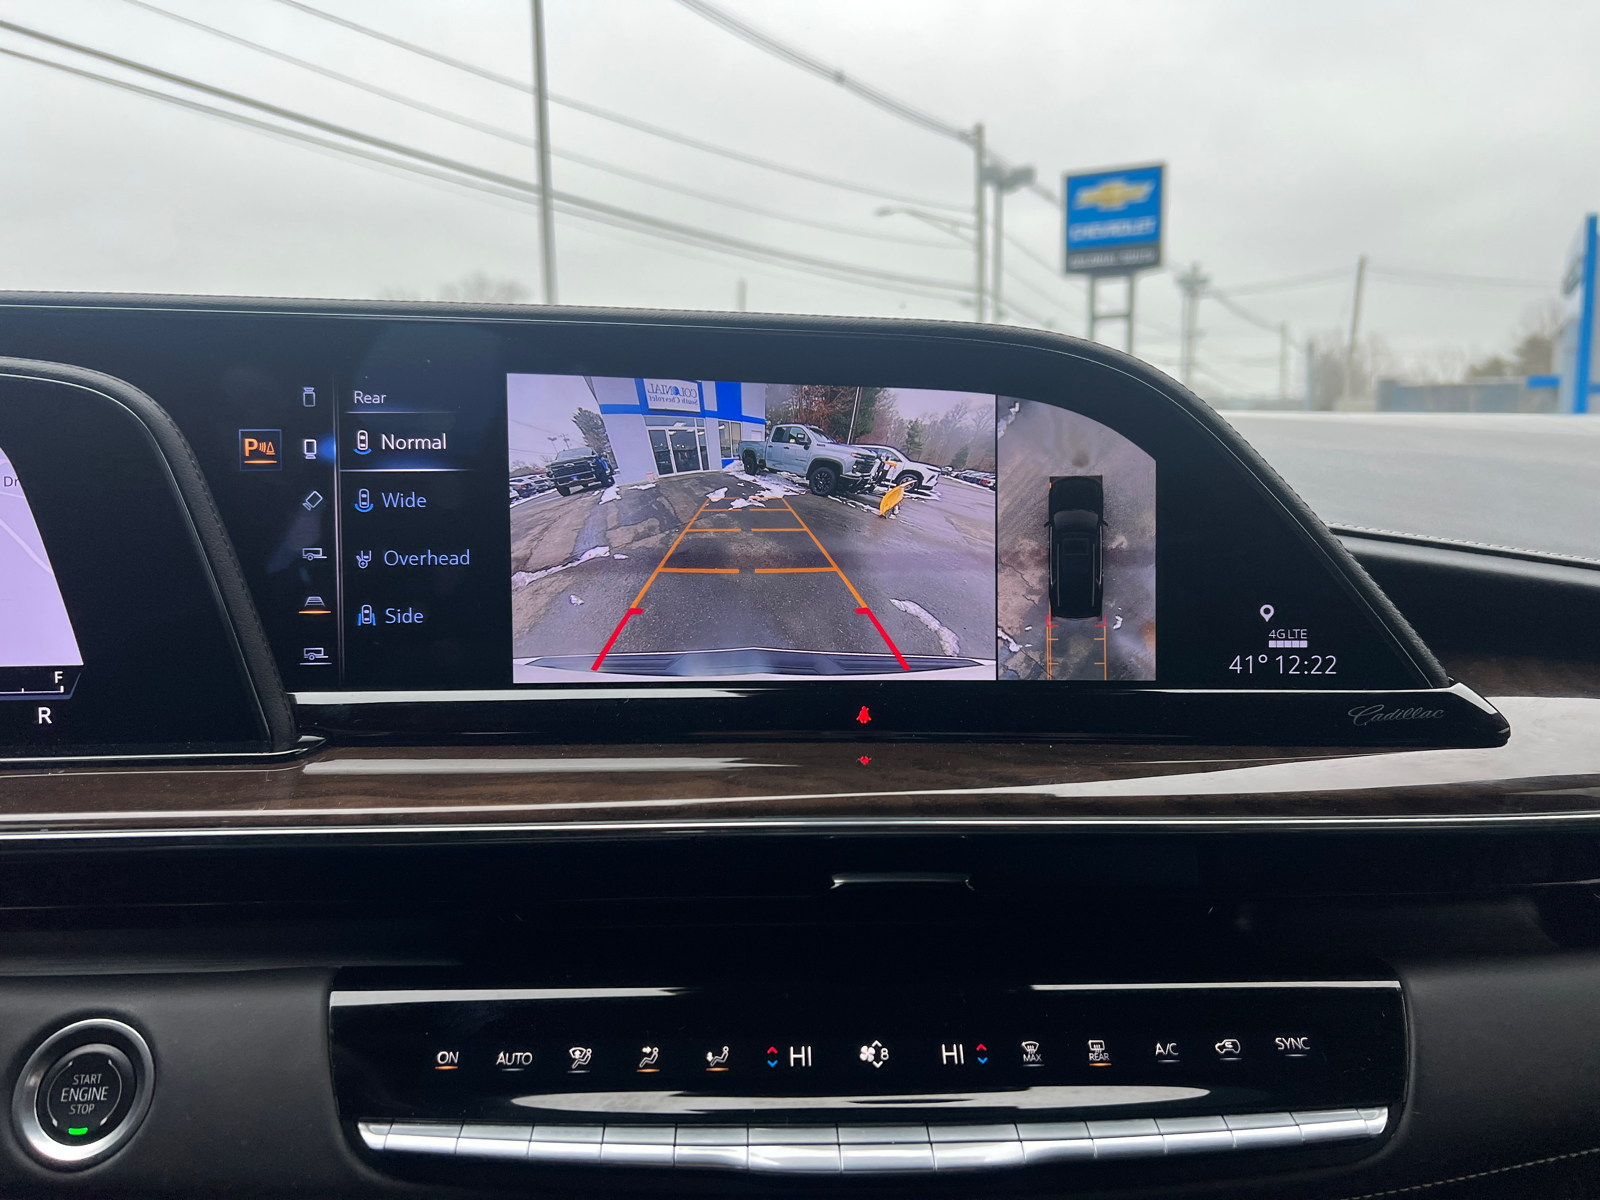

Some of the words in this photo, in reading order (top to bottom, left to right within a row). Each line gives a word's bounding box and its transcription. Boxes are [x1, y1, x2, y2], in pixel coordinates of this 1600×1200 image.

[354, 391, 387, 404] Rear
[381, 433, 447, 451] Normal
[382, 492, 427, 508] Wide
[384, 549, 470, 566] Overhead
[385, 608, 424, 624] Side
[1228, 654, 1268, 674] 41°
[1276, 655, 1337, 675] 12:22
[54, 671, 64, 684] F
[38, 707, 52, 724] R
[1348, 704, 1444, 726] Cadillac
[1155, 1043, 1179, 1057] A/C
[1274, 1037, 1310, 1051] SYNC
[437, 1051, 459, 1066] ON
[496, 1051, 533, 1066] AUTO
[789, 1046, 812, 1067] HI
[942, 1044, 964, 1065] HI
[1024, 1053, 1042, 1063] MAX
[1089, 1052, 1110, 1062] REAR
[73, 1073, 102, 1085] START
[60, 1086, 109, 1102] ENGINE
[69, 1104, 95, 1115] STOP
